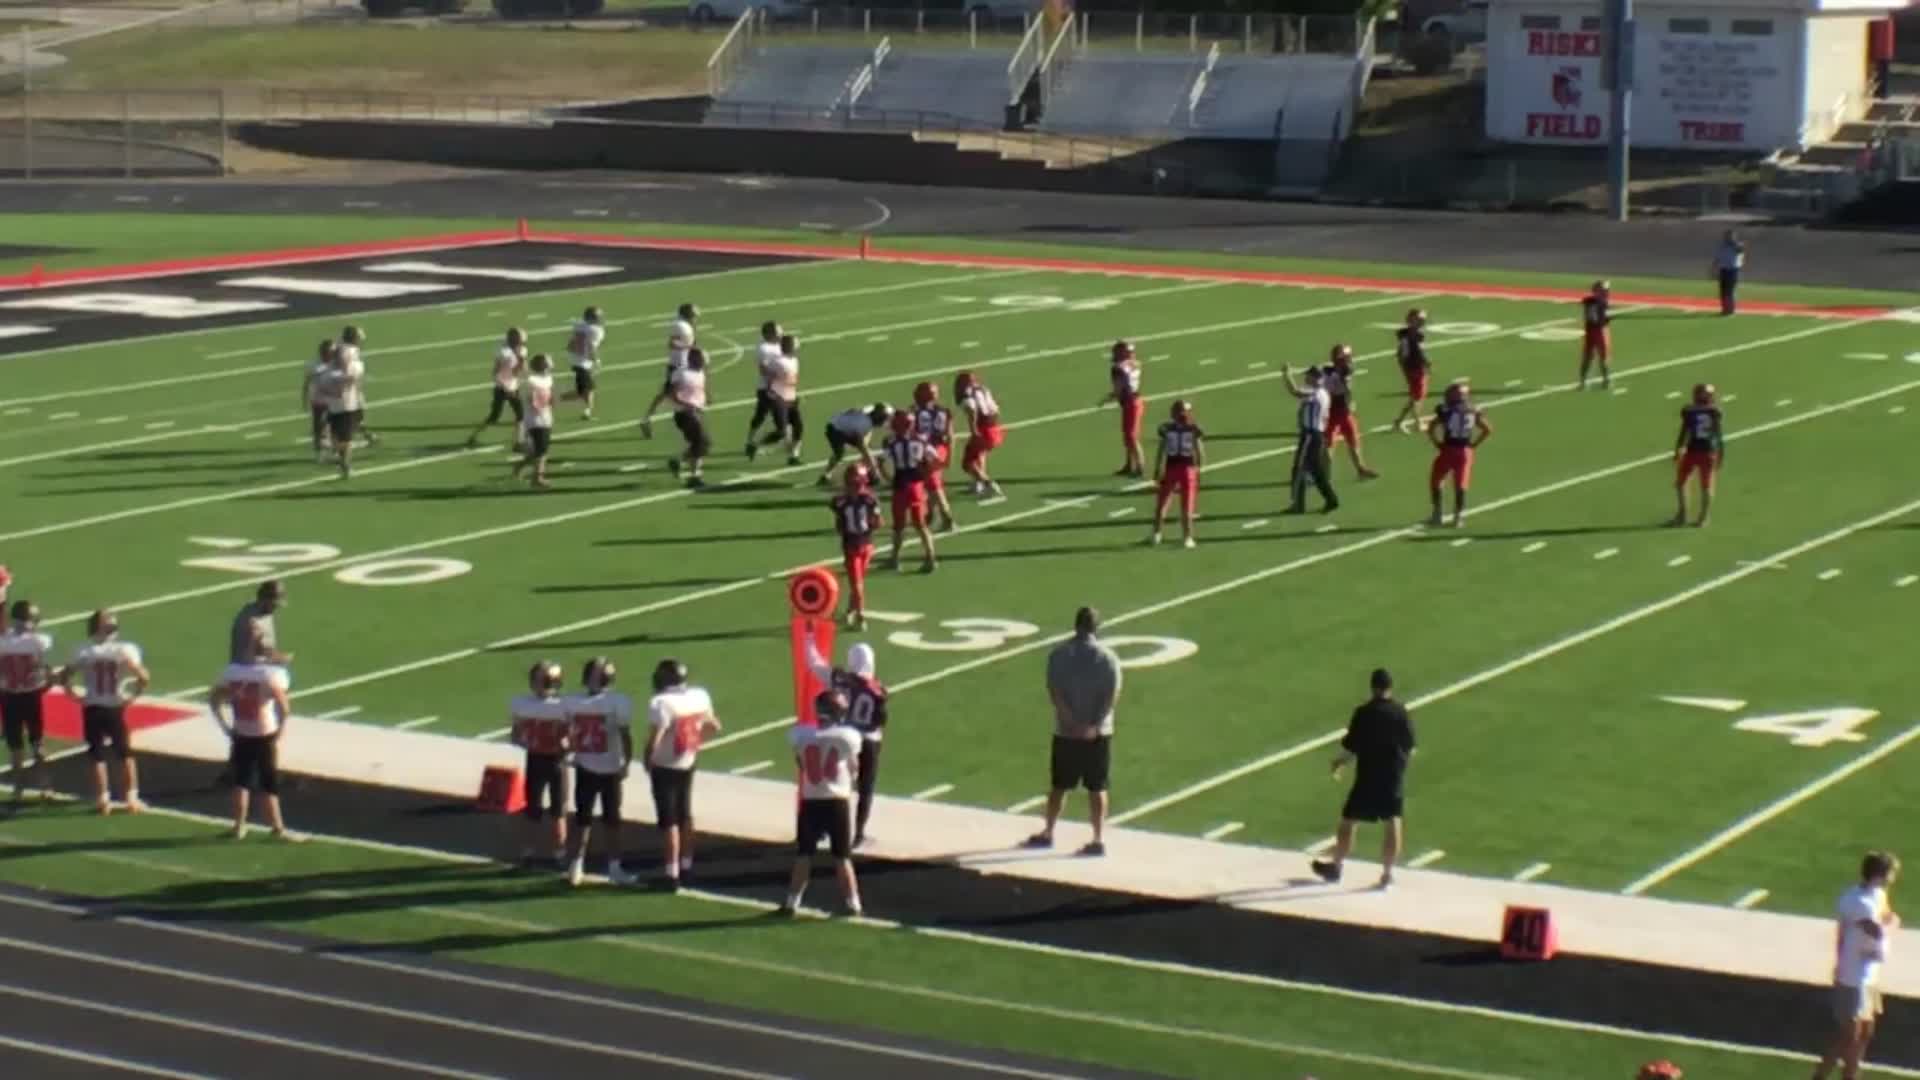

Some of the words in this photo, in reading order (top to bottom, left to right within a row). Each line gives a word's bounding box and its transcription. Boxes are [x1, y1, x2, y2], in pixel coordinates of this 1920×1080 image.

[1526, 113, 1601, 138] FIELD
[1680, 121, 1745, 142] TRIBE
[180, 543, 473, 585] 20
[888, 618, 1198, 667] 30
[1733, 707, 1879, 746] 4
[1506, 914, 1545, 952] 40
